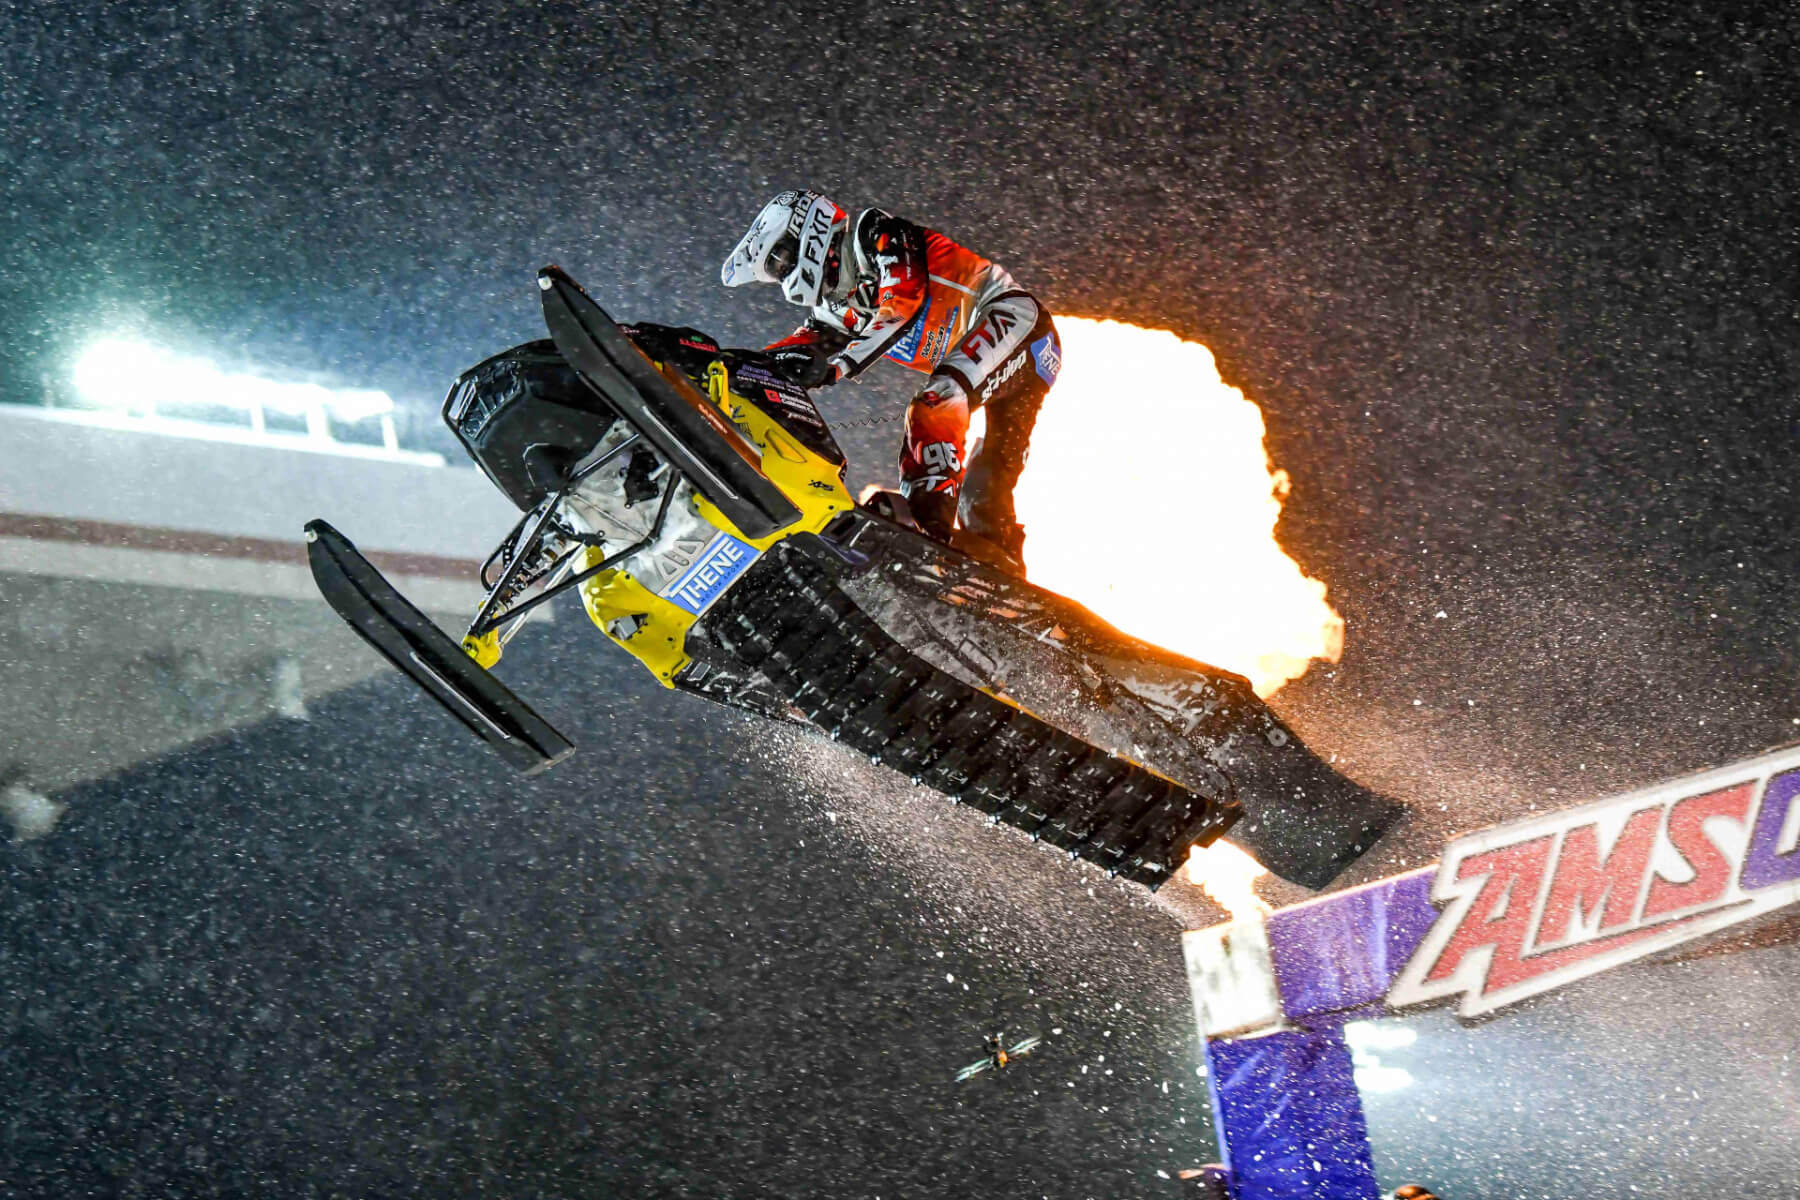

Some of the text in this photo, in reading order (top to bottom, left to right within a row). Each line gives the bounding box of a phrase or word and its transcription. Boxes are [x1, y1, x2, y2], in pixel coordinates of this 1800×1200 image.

[805, 207, 832, 265] FXR
[923, 441, 961, 474] 96
[669, 536, 744, 610] THENE
